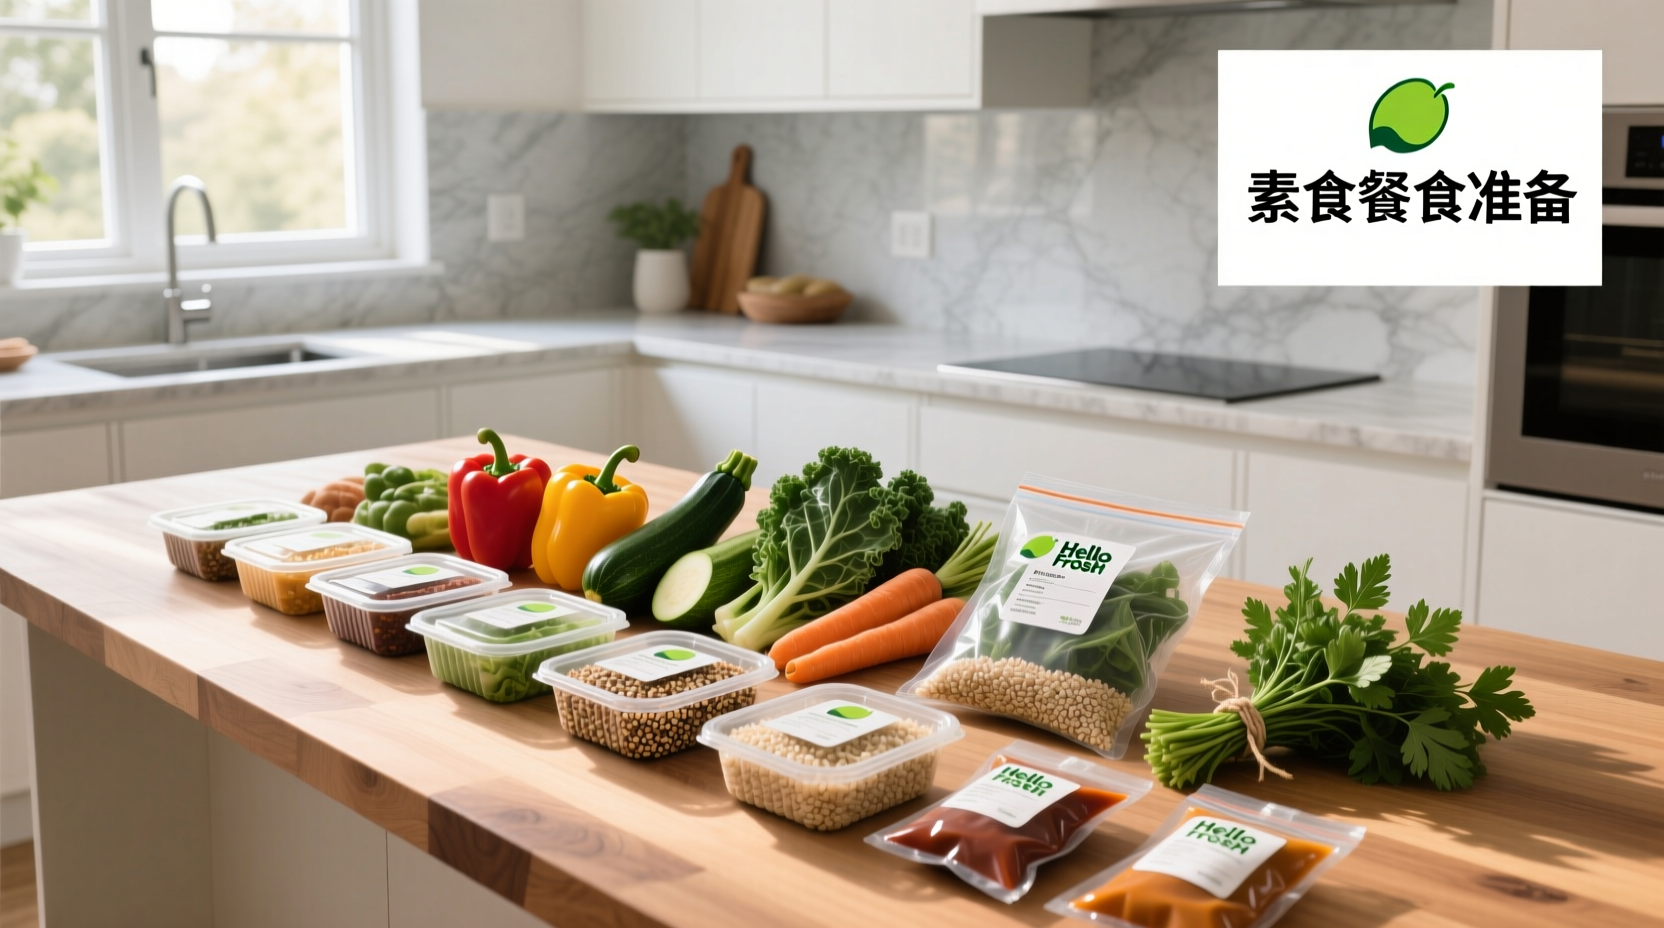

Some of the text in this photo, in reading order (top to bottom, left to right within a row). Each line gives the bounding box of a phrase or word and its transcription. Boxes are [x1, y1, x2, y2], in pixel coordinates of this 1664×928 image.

[1060, 541, 1112, 563] Hello
[1001, 766, 1053, 789] Hello
[1194, 820, 1257, 844] Hello
